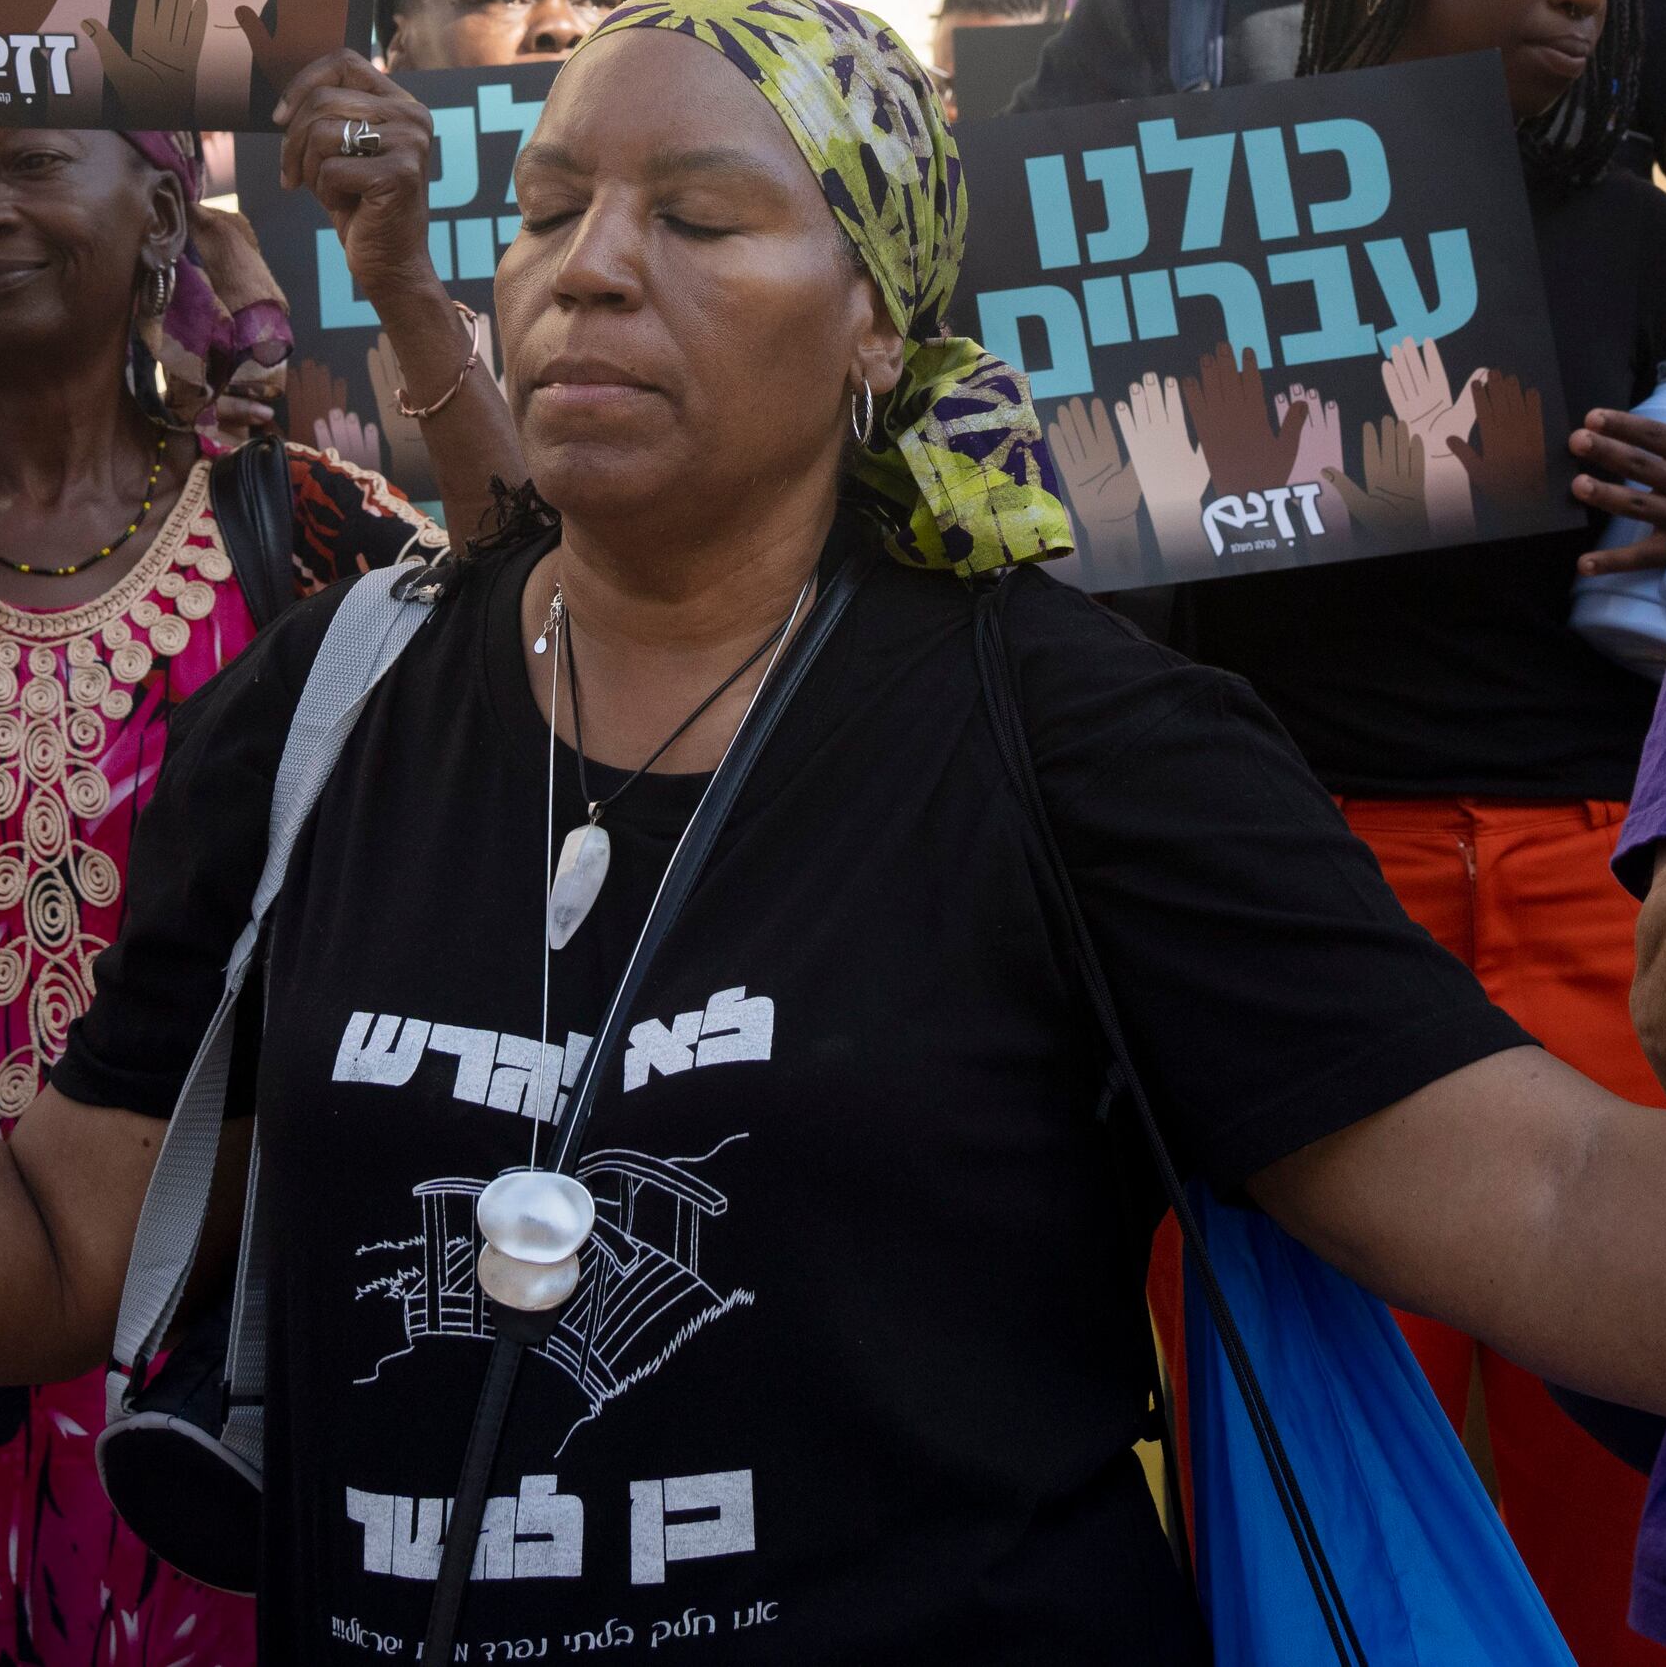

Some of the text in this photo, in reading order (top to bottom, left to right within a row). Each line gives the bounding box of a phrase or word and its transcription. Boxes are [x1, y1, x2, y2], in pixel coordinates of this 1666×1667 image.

[1024, 117, 1392, 270] כולנו
[977, 227, 1479, 400] עבריים
[650, 1607, 716, 1648] חלק
[733, 1600, 779, 1630] אנו
[481, 1638, 548, 1662] נפרד
[563, 1618, 635, 1652] בלתי
